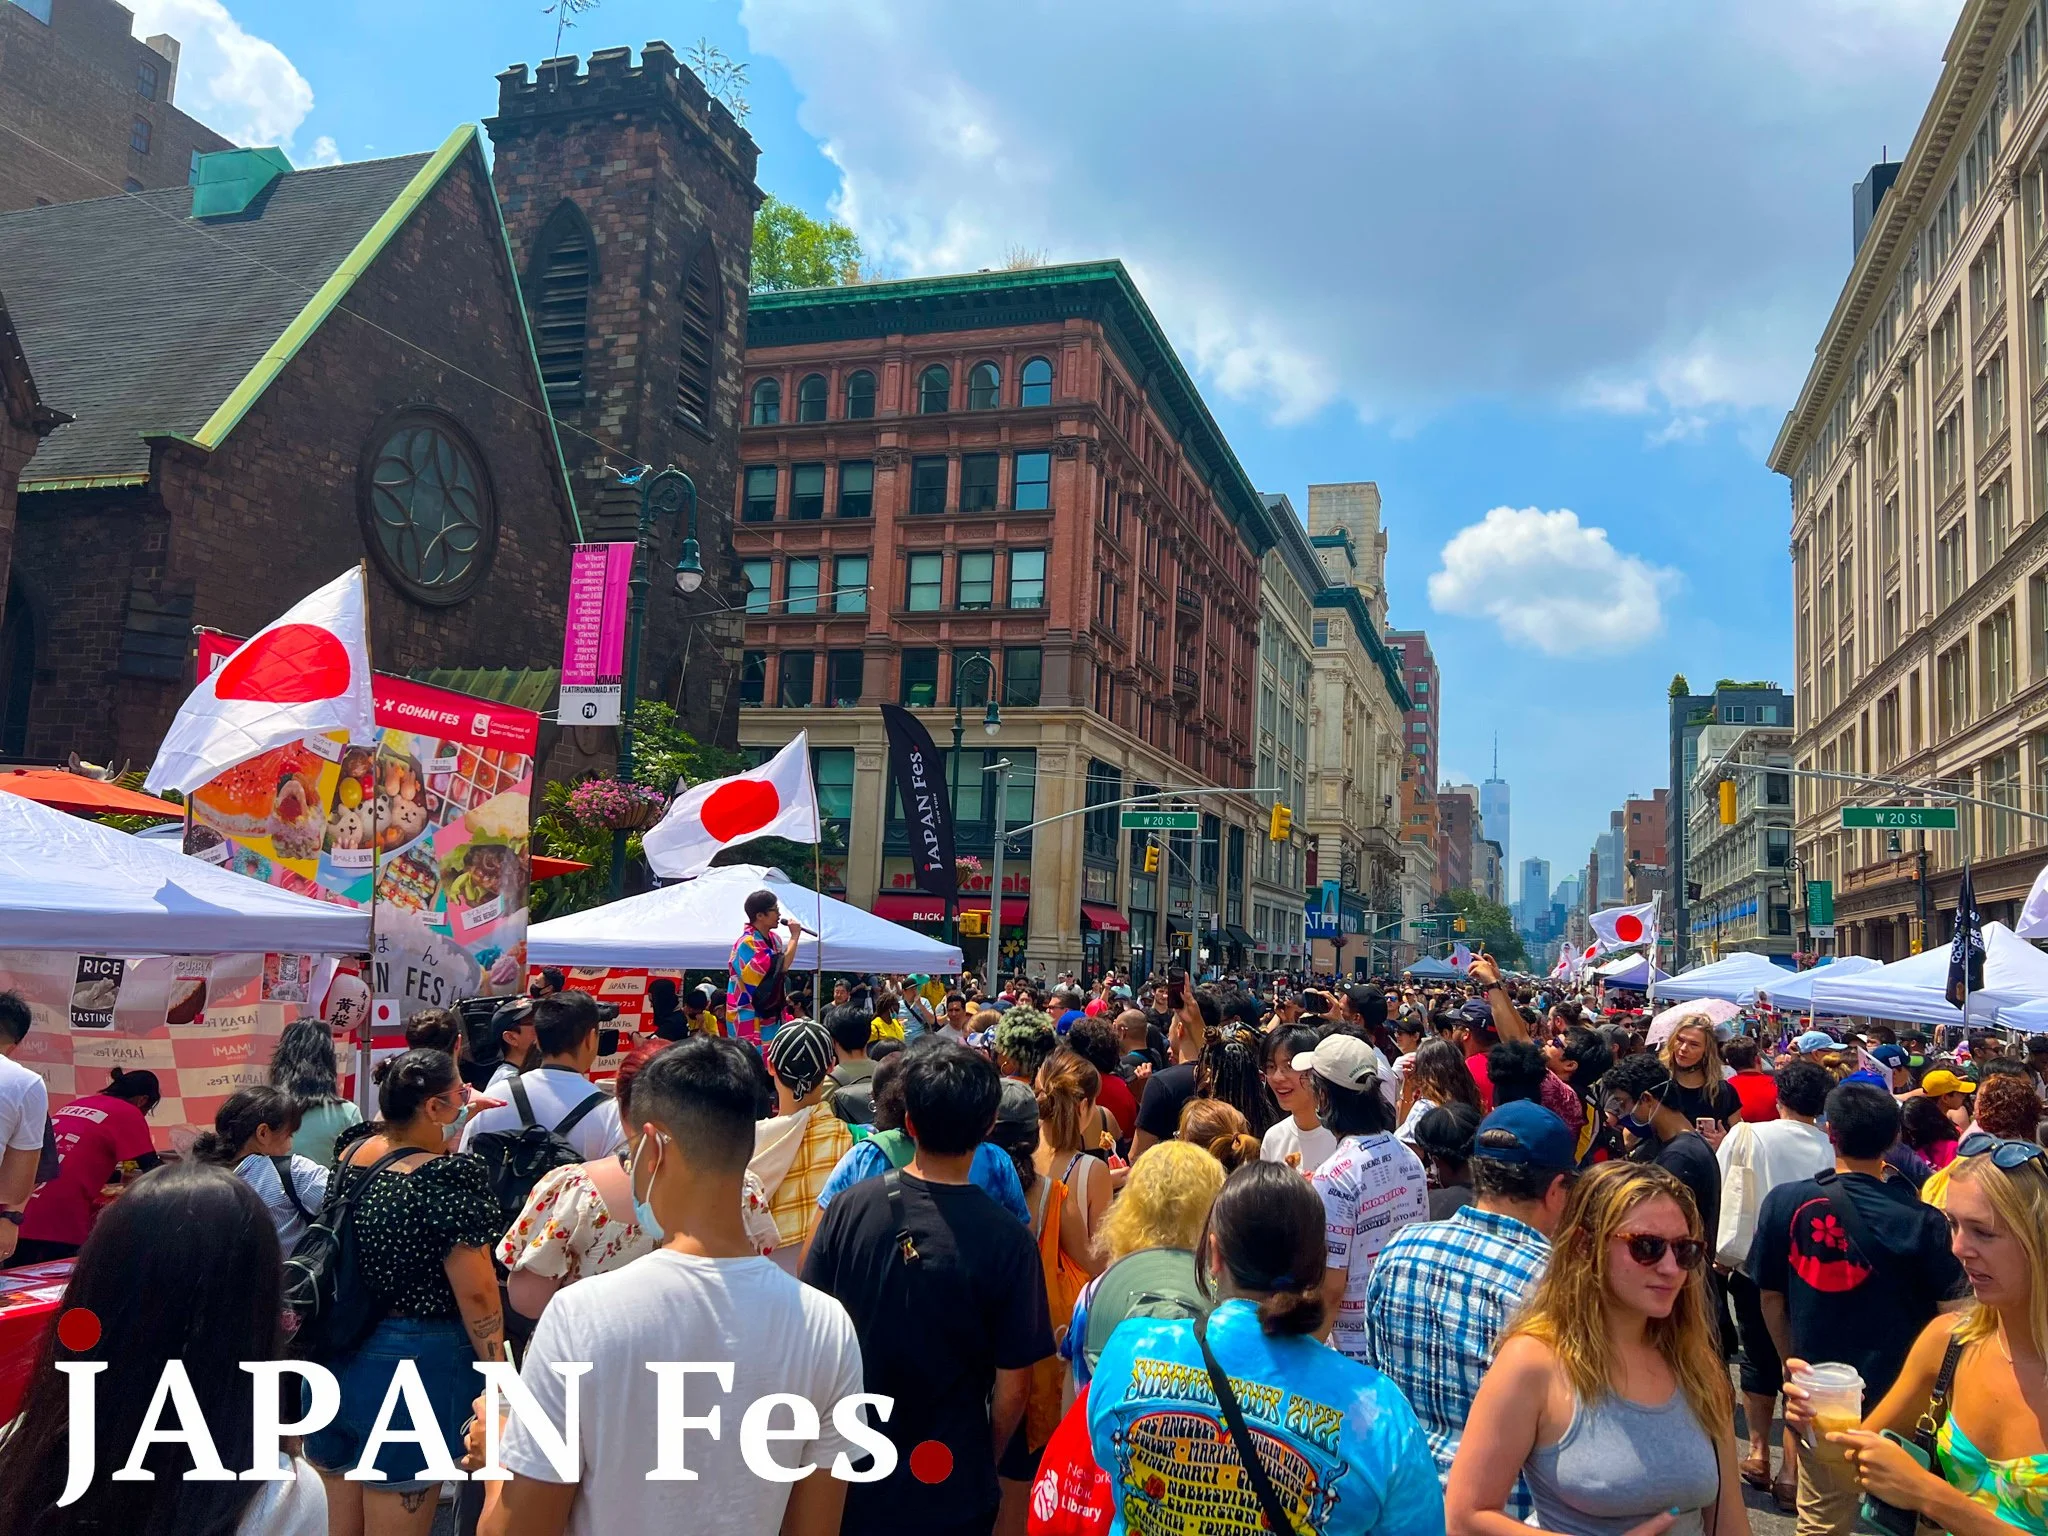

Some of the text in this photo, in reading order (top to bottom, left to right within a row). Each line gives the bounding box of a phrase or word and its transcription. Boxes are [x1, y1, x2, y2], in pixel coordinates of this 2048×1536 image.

[564, 669, 595, 677] New York
[596, 674, 622, 685] NOMAD
[561, 686, 621, 694] FLATIRONNOMAD.NYC
[397, 702, 438, 721] GOHAN
[438, 711, 460, 727] FES
[1143, 816, 1176, 826] W 20 St
[1875, 813, 1923, 825] W 20 St
[916, 794, 944, 871] JAPAN
[912, 912, 941, 921] BLICK
[83, 959, 122, 976] RICE
[177, 959, 211, 972] CURRY
[405, 966, 445, 1007] FES
[608, 982, 627, 990] JAPAN
[71, 1012, 114, 1024] TASTING
[58, 1107, 98, 1117] STAFF
[1138, 1416, 1217, 1441] LOS ANGELES
[1284, 1393, 1345, 1459] 2022
[1134, 1428, 1177, 1460] BOULDER
[1136, 1449, 1220, 1485] CINCINNATI
[1061, 1494, 1102, 1523] Library
[1167, 1497, 1258, 1526] CLARKSTON
